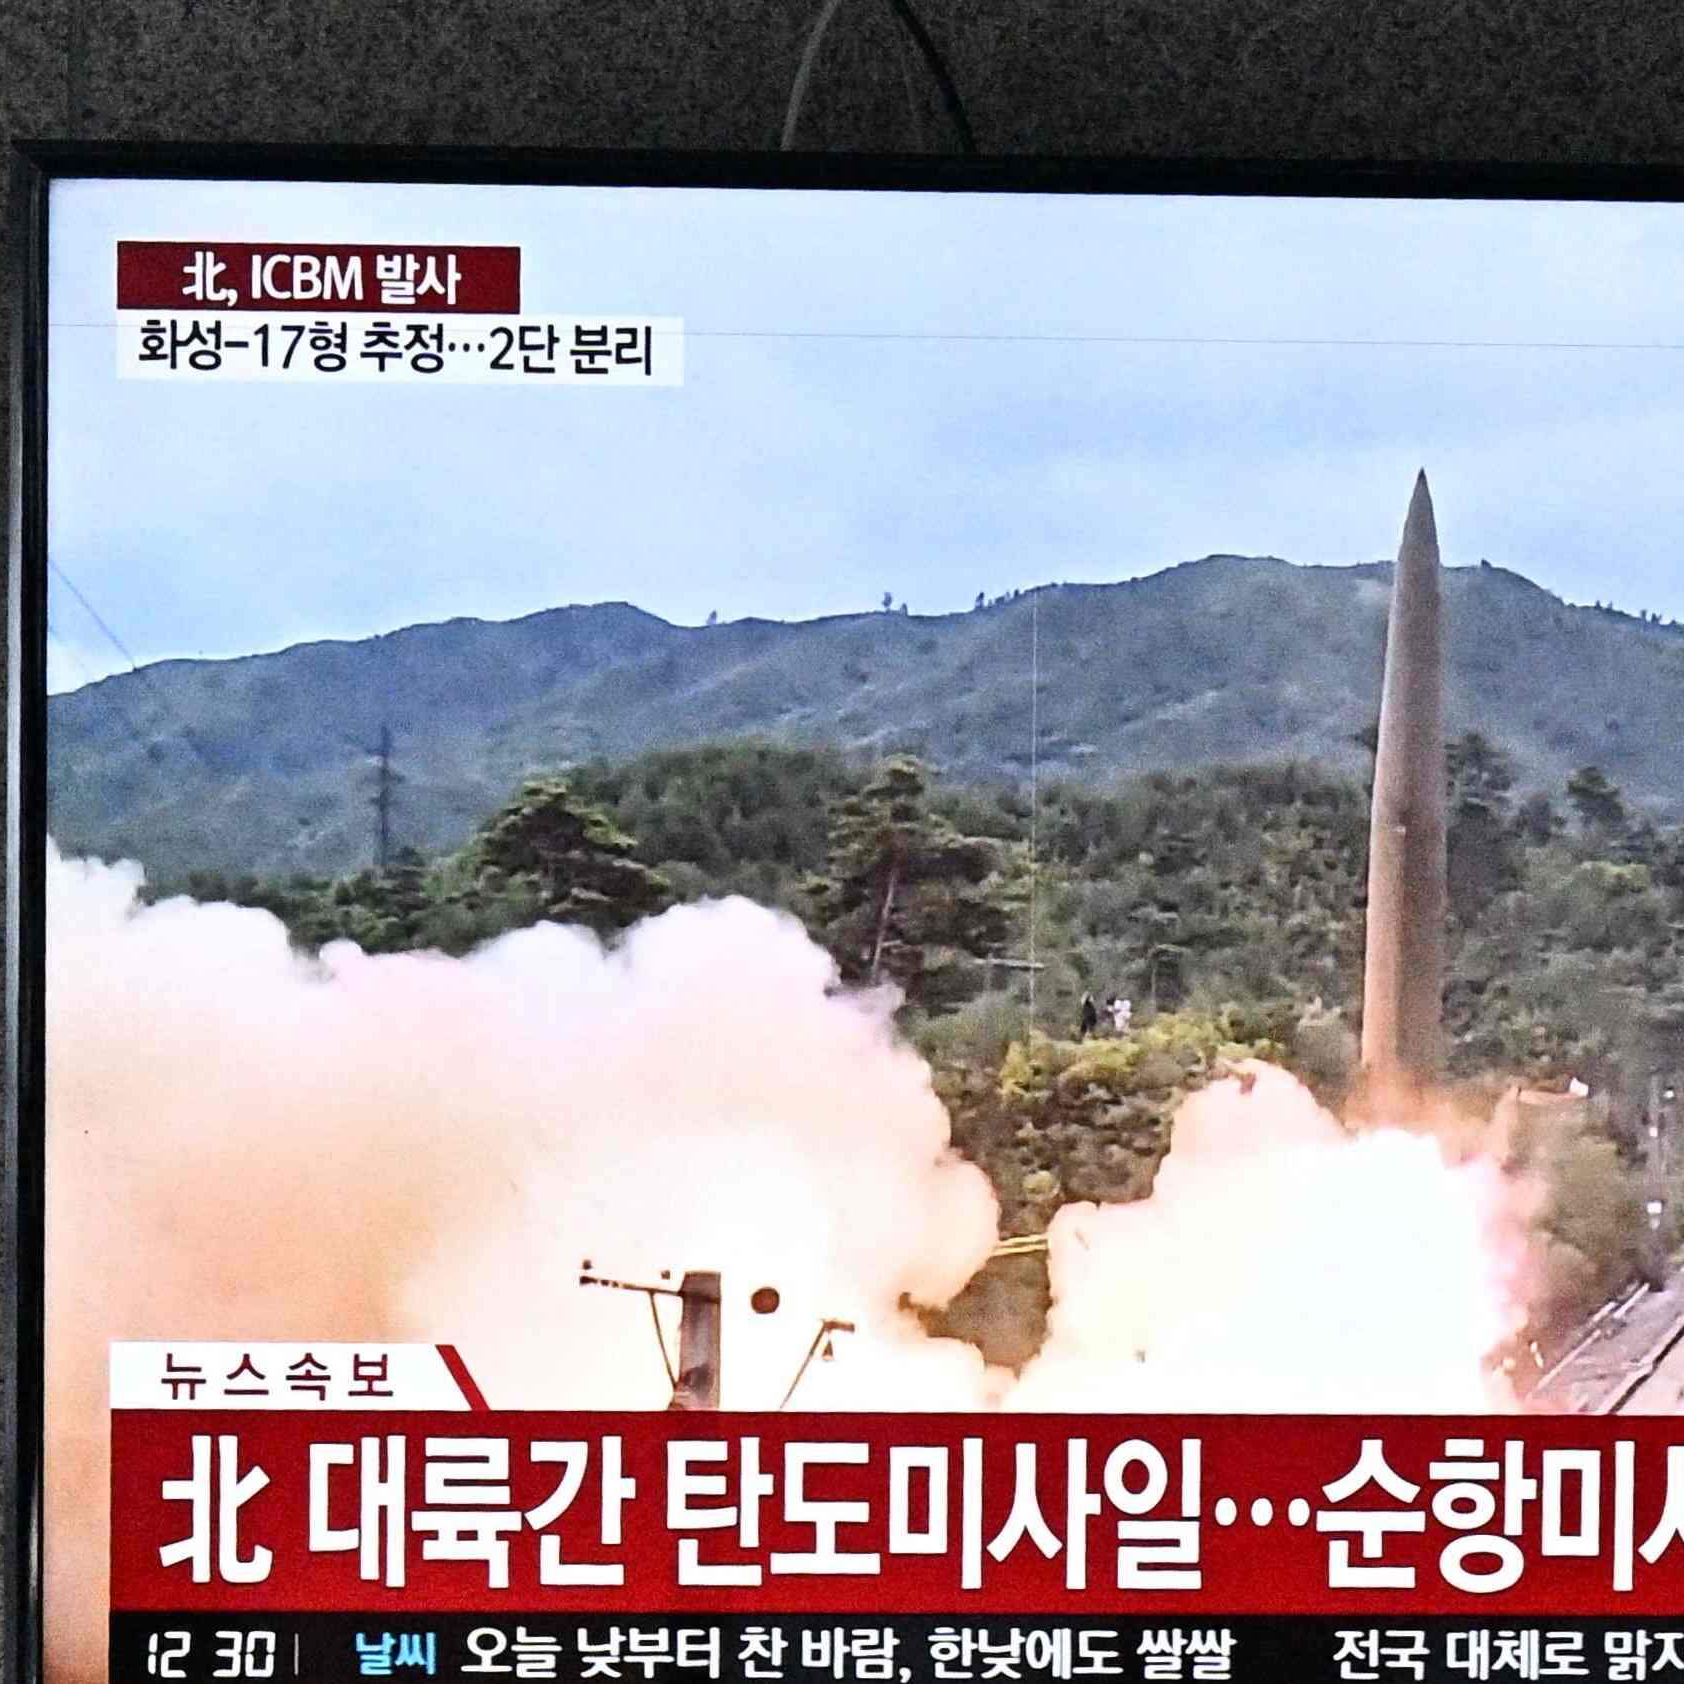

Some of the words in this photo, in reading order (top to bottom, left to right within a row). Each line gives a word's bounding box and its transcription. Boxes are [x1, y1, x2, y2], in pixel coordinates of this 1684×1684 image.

[182, 252, 237, 307] 北,
[252, 256, 363, 301] ICBM
[376, 253, 462, 306] 발사
[138, 318, 349, 372] 화성-17형
[569, 323, 654, 377] 분리
[160, 1352, 396, 1401] 뉴스속보
[158, 1434, 274, 1585] 北
[307, 1434, 637, 1590] 대륙간
[146, 1630, 191, 1679] 12
[212, 1630, 276, 1679] 30
[354, 1632, 438, 1676] 날씨
[459, 1627, 563, 1680] 오늘
[576, 1627, 721, 1680] 낮부터
[736, 1627, 787, 1680] 찬
[801, 1627, 912, 1684] 바람,
[927, 1627, 1124, 1680] 한낮에도
[1136, 1628, 1237, 1682] 쌀쌀
[1332, 1629, 1432, 1681] 전국
[1445, 1629, 1591, 1682] 대체로
